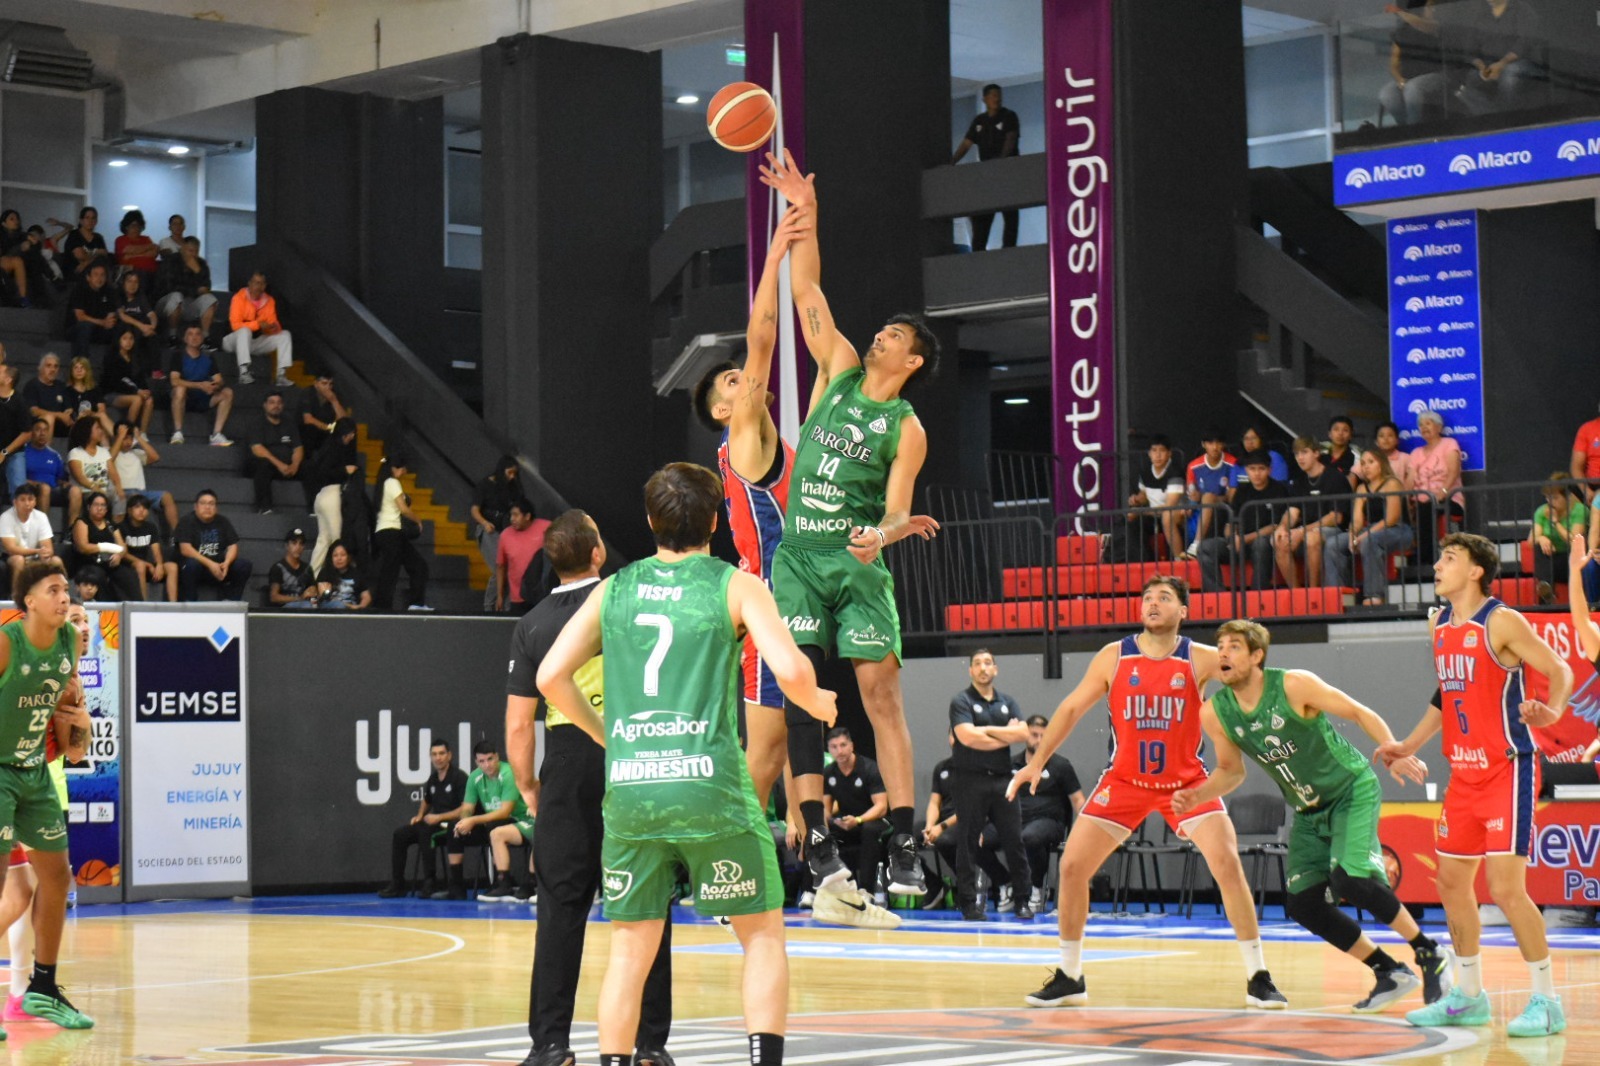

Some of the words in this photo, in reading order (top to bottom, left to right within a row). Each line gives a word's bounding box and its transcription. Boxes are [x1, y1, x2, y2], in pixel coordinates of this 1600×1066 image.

[1478, 149, 1532, 169] Macro
[1055, 67, 1108, 273] seguir
[1373, 163, 1425, 183] Macro
[1423, 242, 1462, 257] Macro
[1425, 295, 1464, 308] Macro
[1070, 293, 1098, 339] a
[1427, 346, 1466, 360] Macro
[1429, 398, 1467, 411] Macro
[811, 425, 872, 463] PARQUE
[817, 452, 840, 480] 14
[801, 477, 846, 501] inalpa
[637, 583, 683, 601] VISPO
[634, 612, 673, 697] 7
[18, 691, 64, 708] PARQU
[140, 691, 237, 716] JEMSE
[1123, 695, 1185, 722] JUJUY
[29, 709, 49, 732] 23
[1454, 698, 1469, 735] 6
[104, 721, 113, 738] 2
[611, 716, 708, 742] Agrosabor
[85, 741, 114, 756] ICO
[1138, 740, 1166, 774] 19
[191, 763, 242, 776] JUJUY
[610, 756, 714, 783] ANDRESITO
[1276, 763, 1296, 783] 11
[166, 787, 230, 804] ENERGÍA
[233, 789, 242, 801] Y
[183, 814, 242, 830] MINERÍA
[138, 857, 184, 868] SOCIEDAD
[187, 856, 204, 866] DEL
[207, 855, 242, 865] ESTADO
[701, 879, 756, 895] Rossetti
[701, 890, 757, 900] DEPORTES
